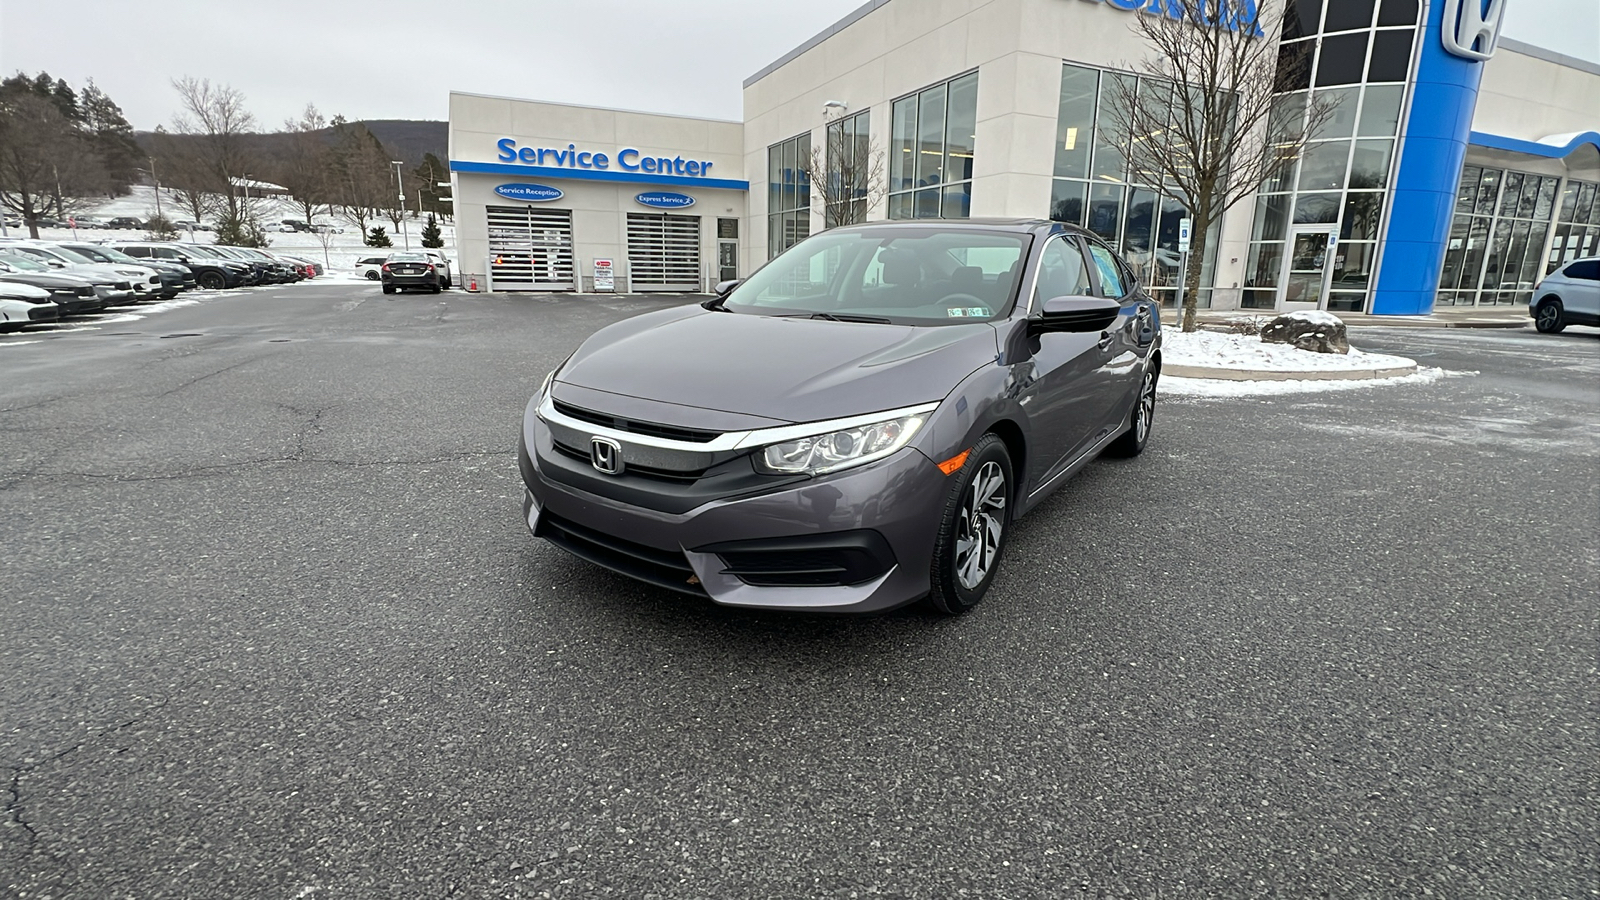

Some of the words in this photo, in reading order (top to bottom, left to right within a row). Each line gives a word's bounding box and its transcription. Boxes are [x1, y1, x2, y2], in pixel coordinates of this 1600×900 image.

[497, 138, 609, 169] Service
[618, 148, 713, 176] Center
[498, 187, 525, 195] Service
[525, 188, 560, 197] Reception
[638, 195, 661, 203] Express
[662, 196, 683, 204] Service
